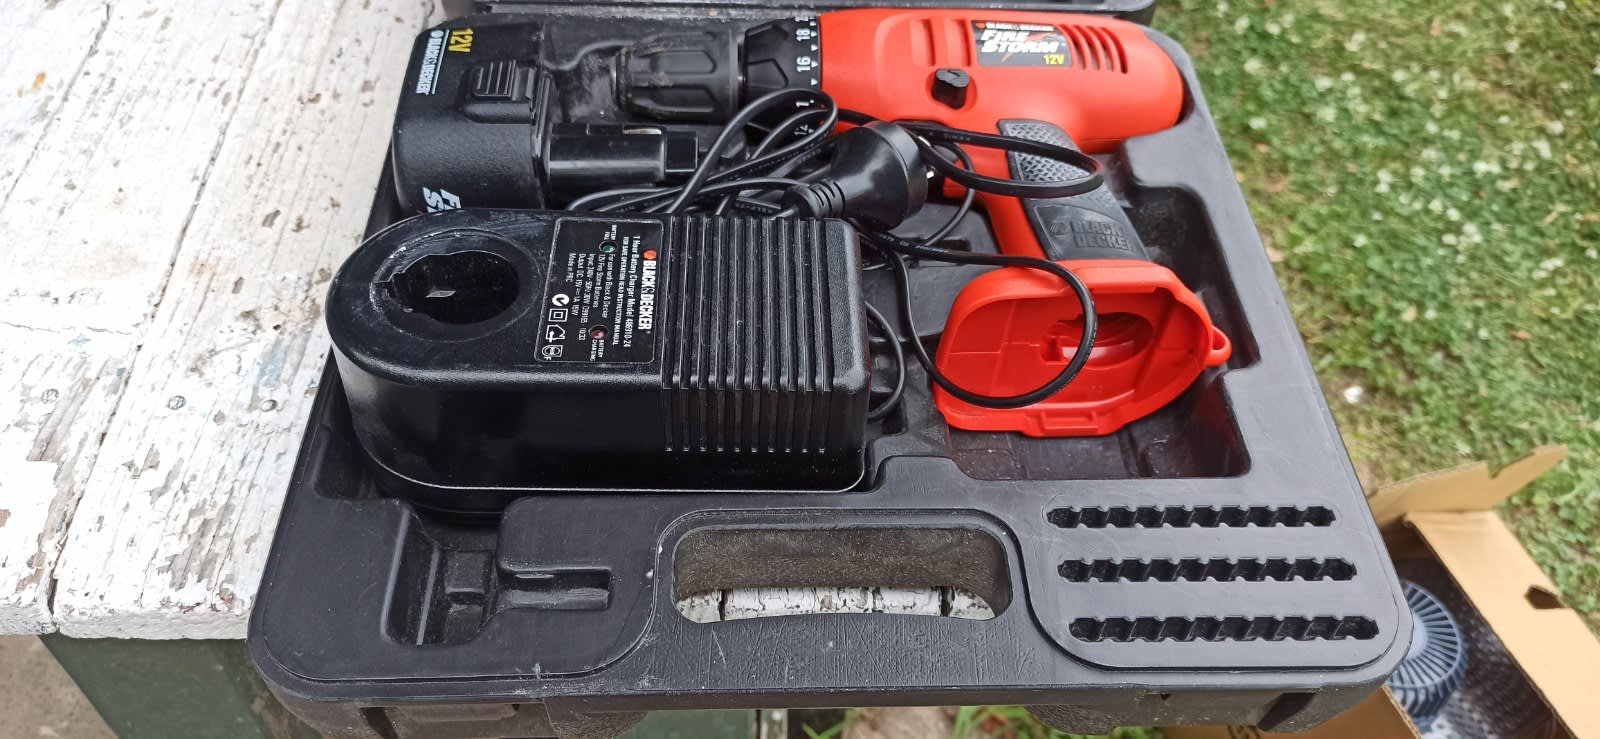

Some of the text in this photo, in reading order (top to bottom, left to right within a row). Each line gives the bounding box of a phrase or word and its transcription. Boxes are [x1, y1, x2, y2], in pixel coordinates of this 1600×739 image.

[449, 28, 473, 53] 12V
[796, 28, 811, 42] 18
[980, 29, 1030, 41] FIRE
[981, 40, 1060, 53] STORM
[796, 56, 811, 73] 16
[1043, 54, 1064, 65] 12V
[631, 239, 640, 253] Hour
[619, 256, 627, 280] OPERATION
[628, 253, 639, 273] Battery
[625, 274, 637, 297] Charger
[614, 293, 623, 323] INSTRUCTION
[625, 298, 635, 317] Model
